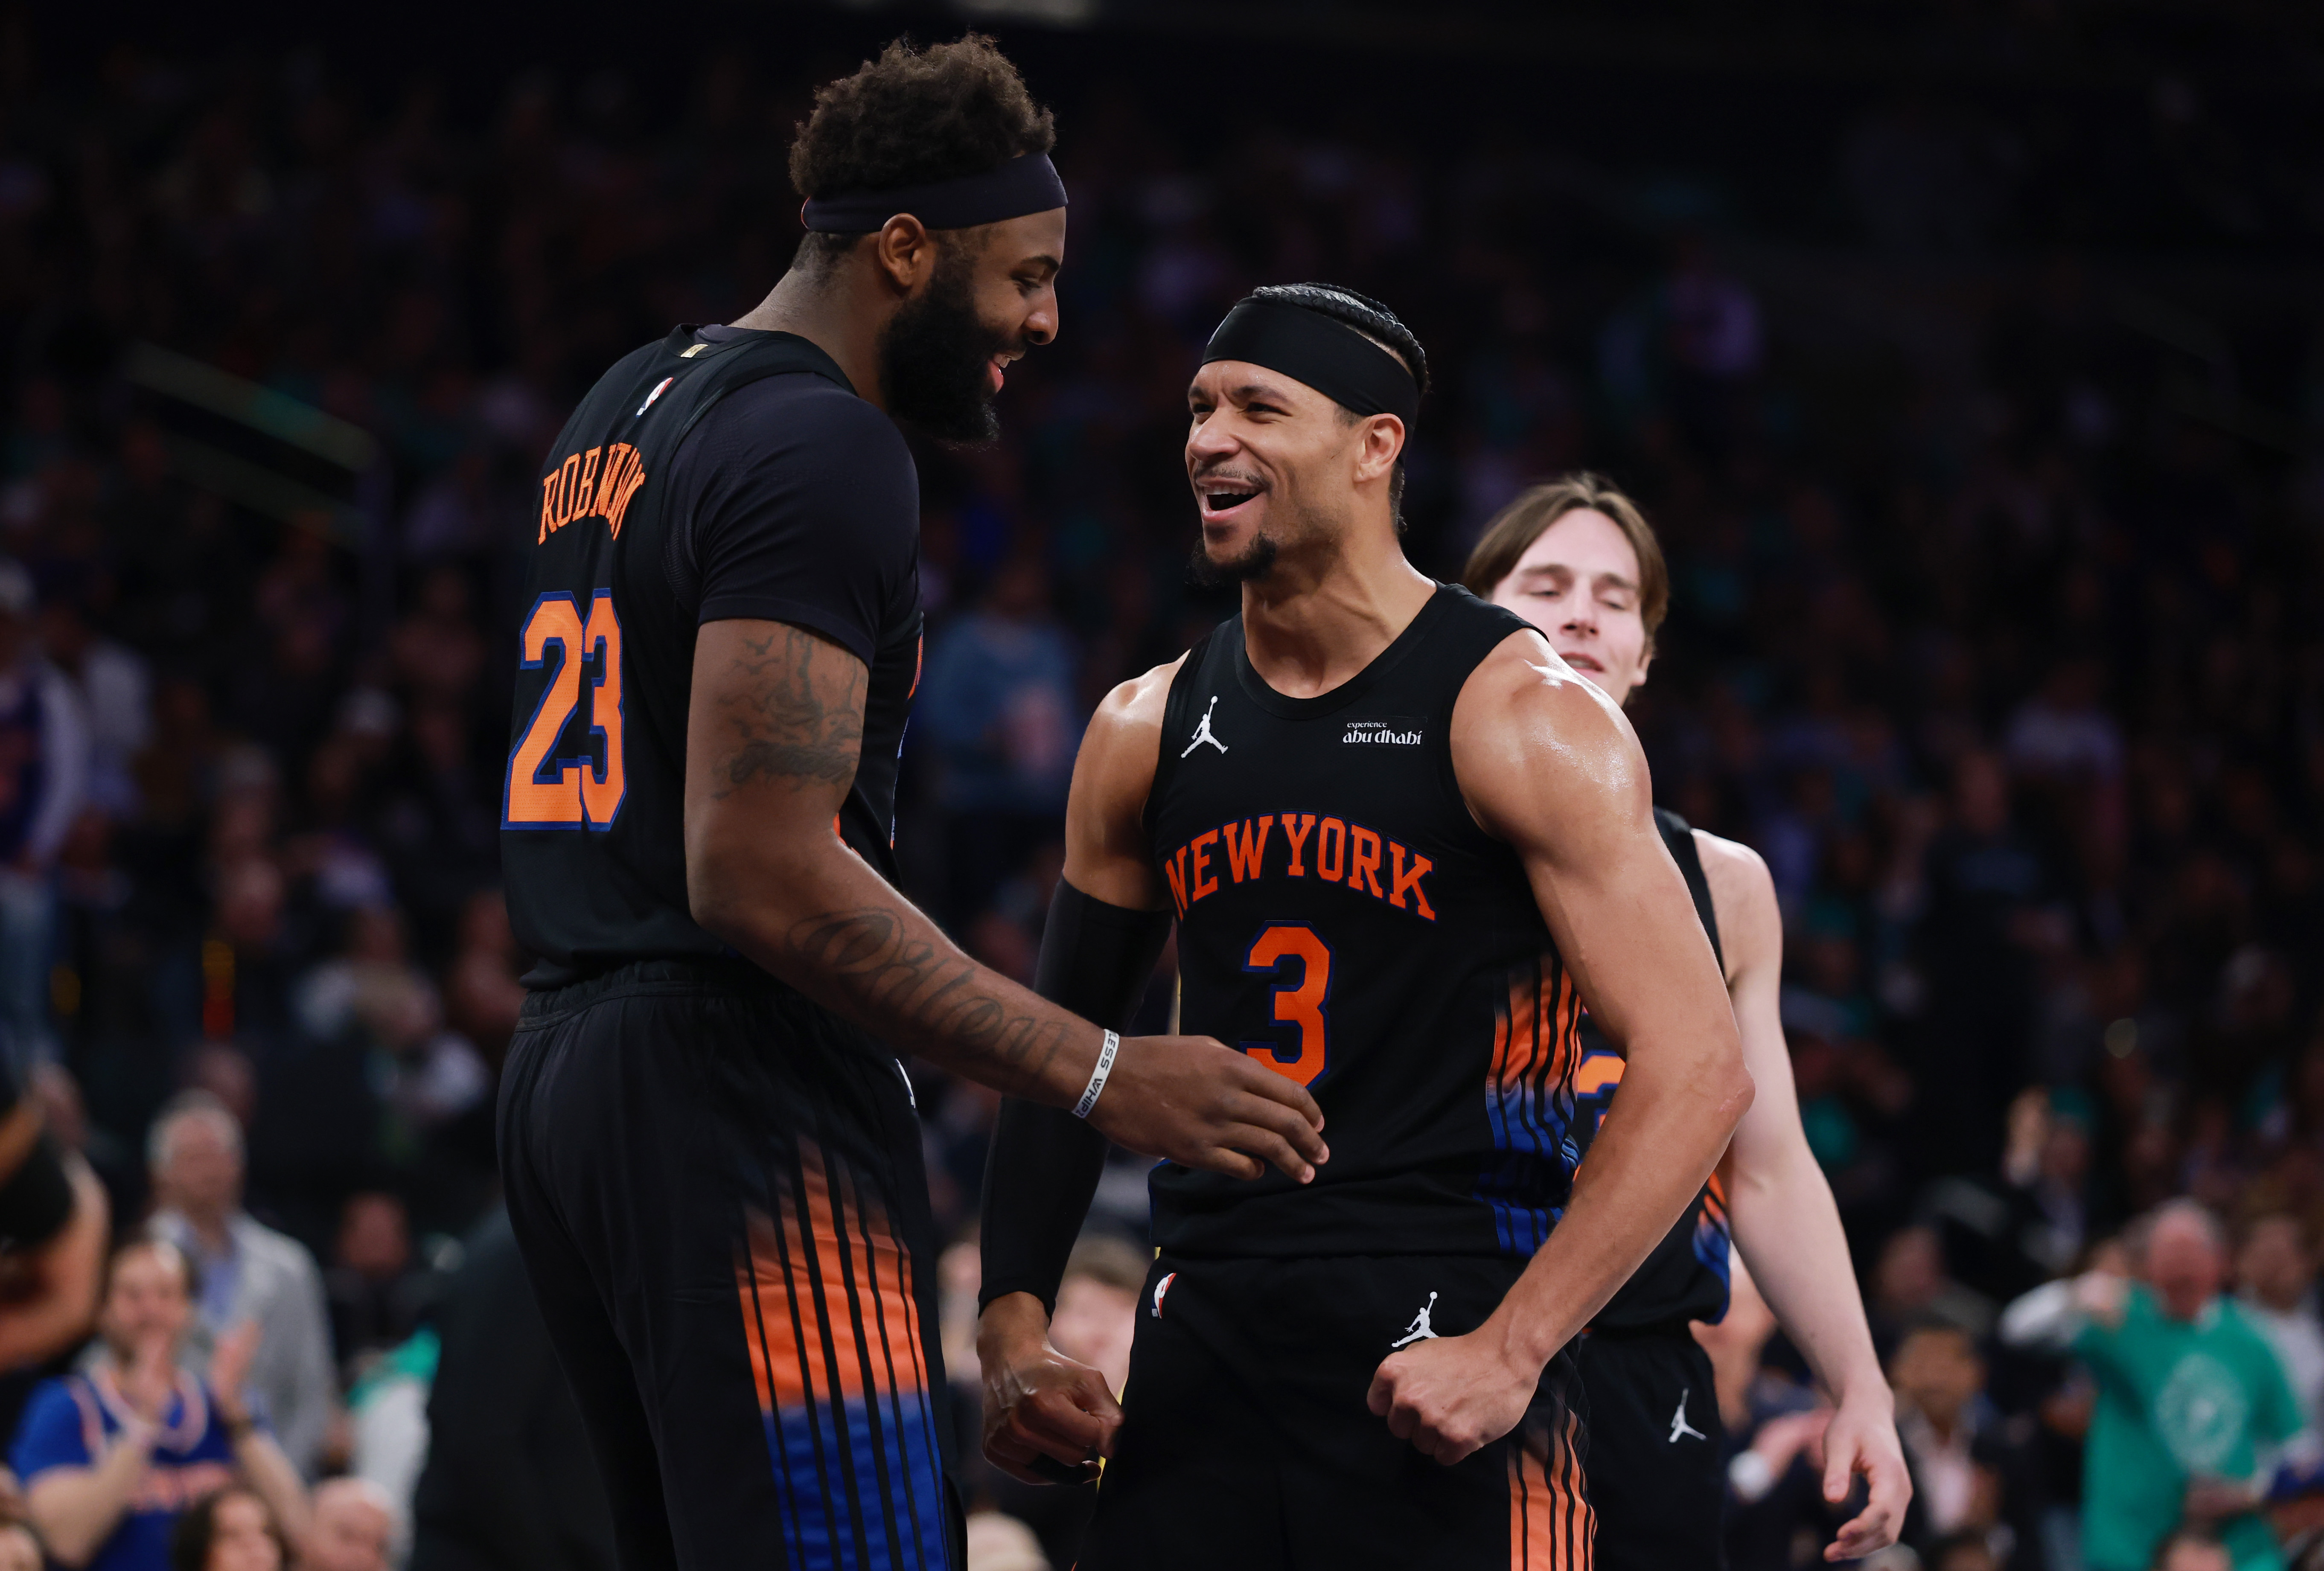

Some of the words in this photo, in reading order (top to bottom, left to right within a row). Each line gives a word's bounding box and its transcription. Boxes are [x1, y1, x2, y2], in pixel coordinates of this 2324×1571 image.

[500, 587, 627, 832] 23
[1343, 729, 1372, 743] abu
[1374, 729, 1423, 745] dhabi
[1346, 720, 1387, 730] experience
[1164, 813, 1275, 922] NEW
[1280, 811, 1437, 923] YORK
[1241, 919, 1336, 1091] 3
